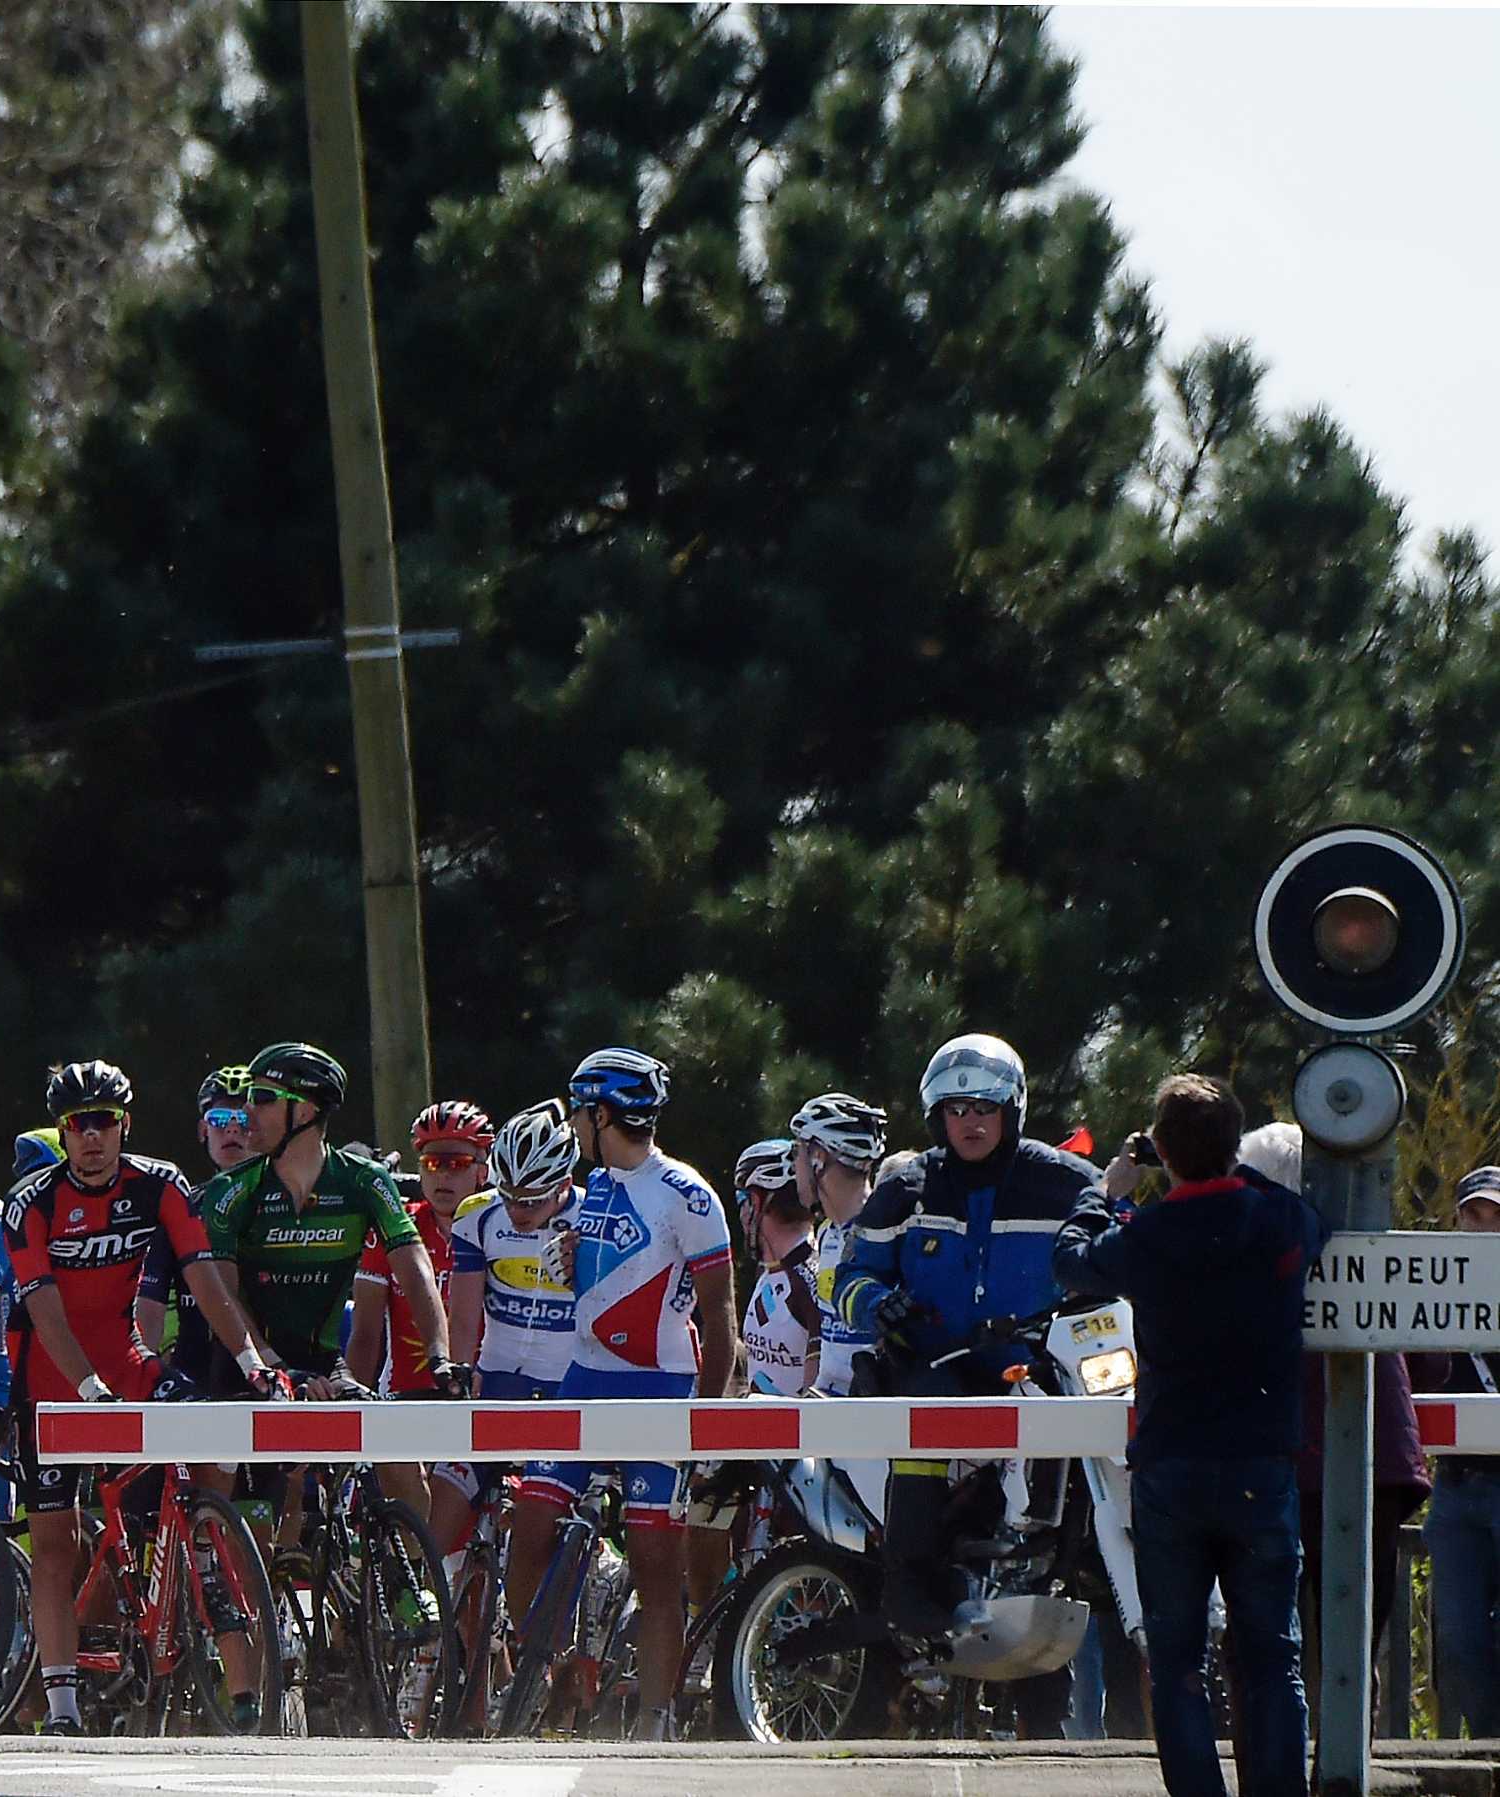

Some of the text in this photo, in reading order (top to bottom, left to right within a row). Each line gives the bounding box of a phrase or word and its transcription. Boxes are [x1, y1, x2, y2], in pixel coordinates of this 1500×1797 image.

[266, 1227, 346, 1247] Europcar
[1308, 1255, 1470, 1285] AIN PEUT
[1356, 1301, 1397, 1330] UN
[1411, 1302, 1500, 1331] AUTR
